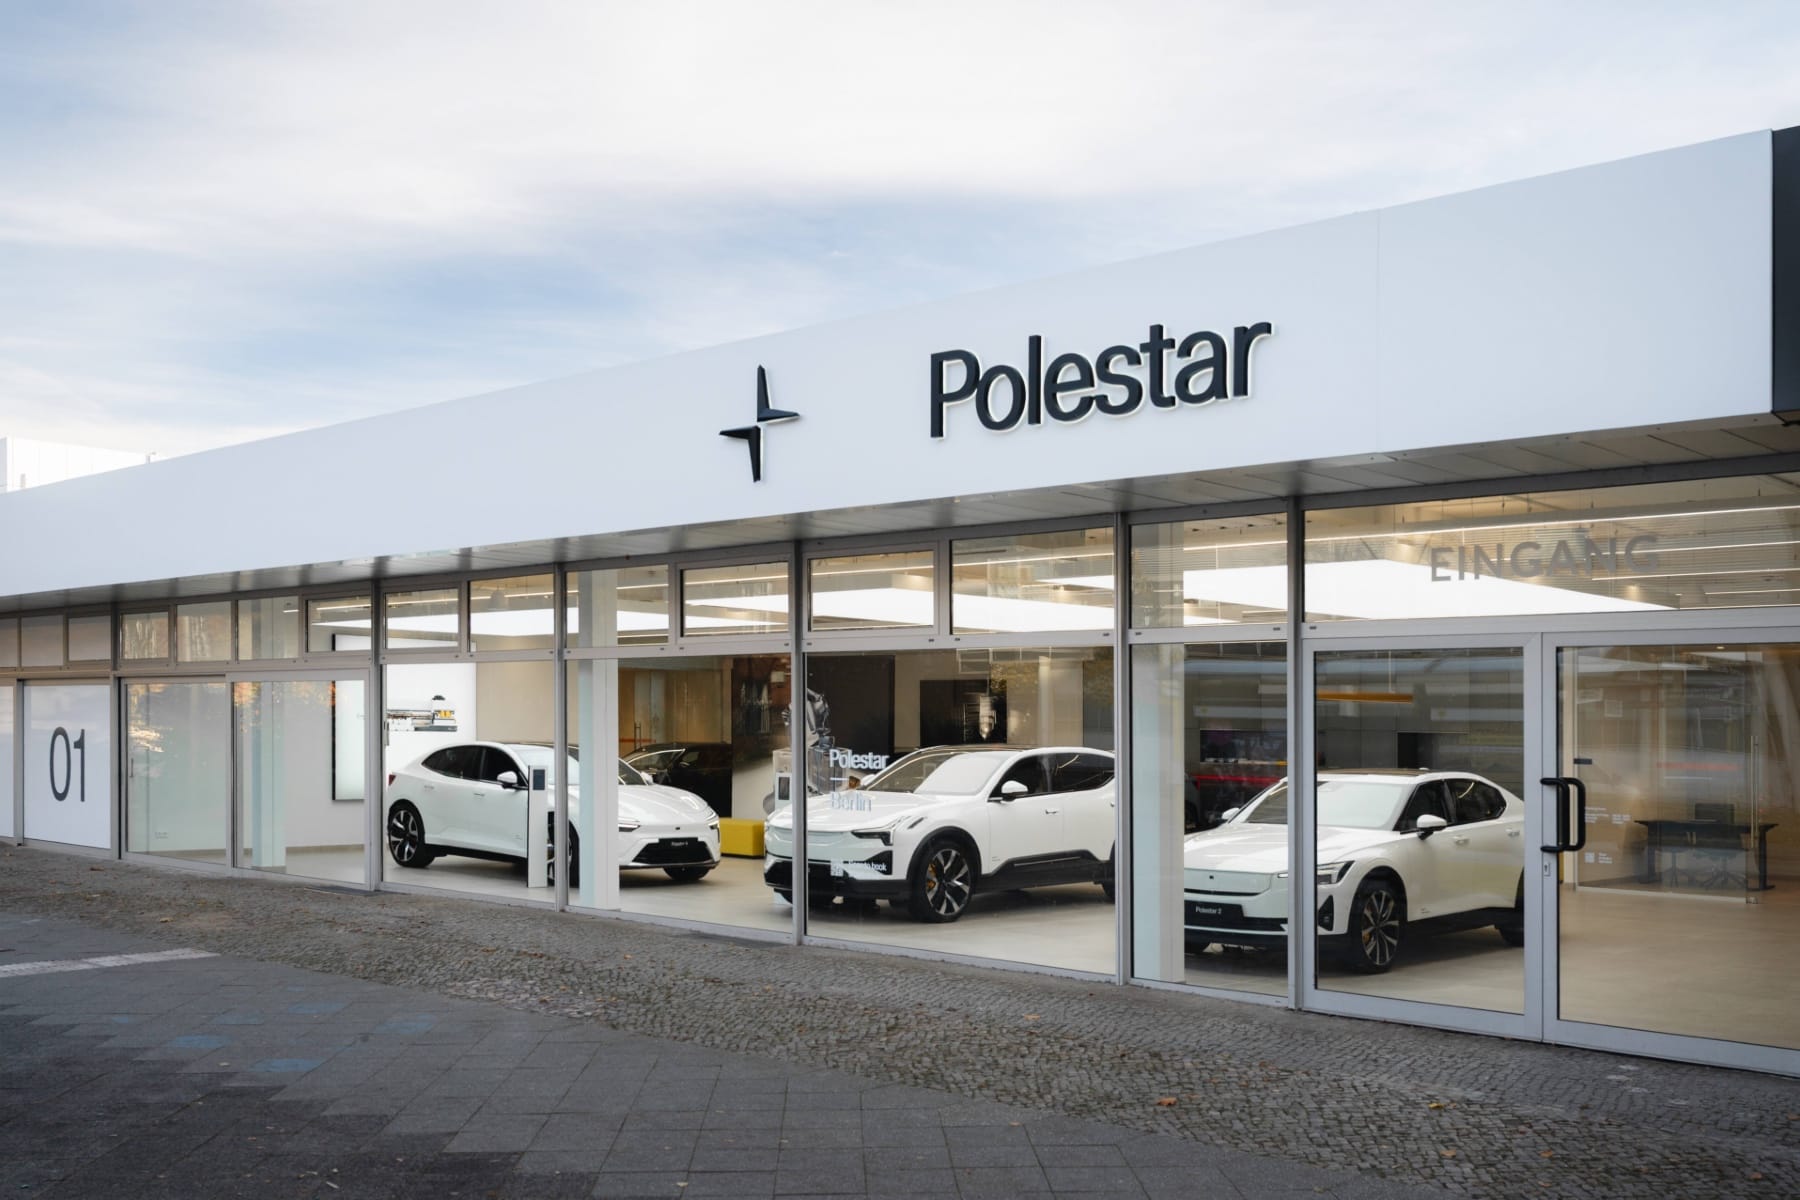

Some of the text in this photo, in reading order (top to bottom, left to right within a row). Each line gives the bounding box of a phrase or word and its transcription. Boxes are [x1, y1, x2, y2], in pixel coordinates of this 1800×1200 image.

[930, 321, 1273, 440] Polestar
[1431, 534, 1660, 582] EINGANG
[49, 726, 85, 803] 01
[829, 749, 889, 769] Polestar
[831, 792, 872, 811] Berlin
